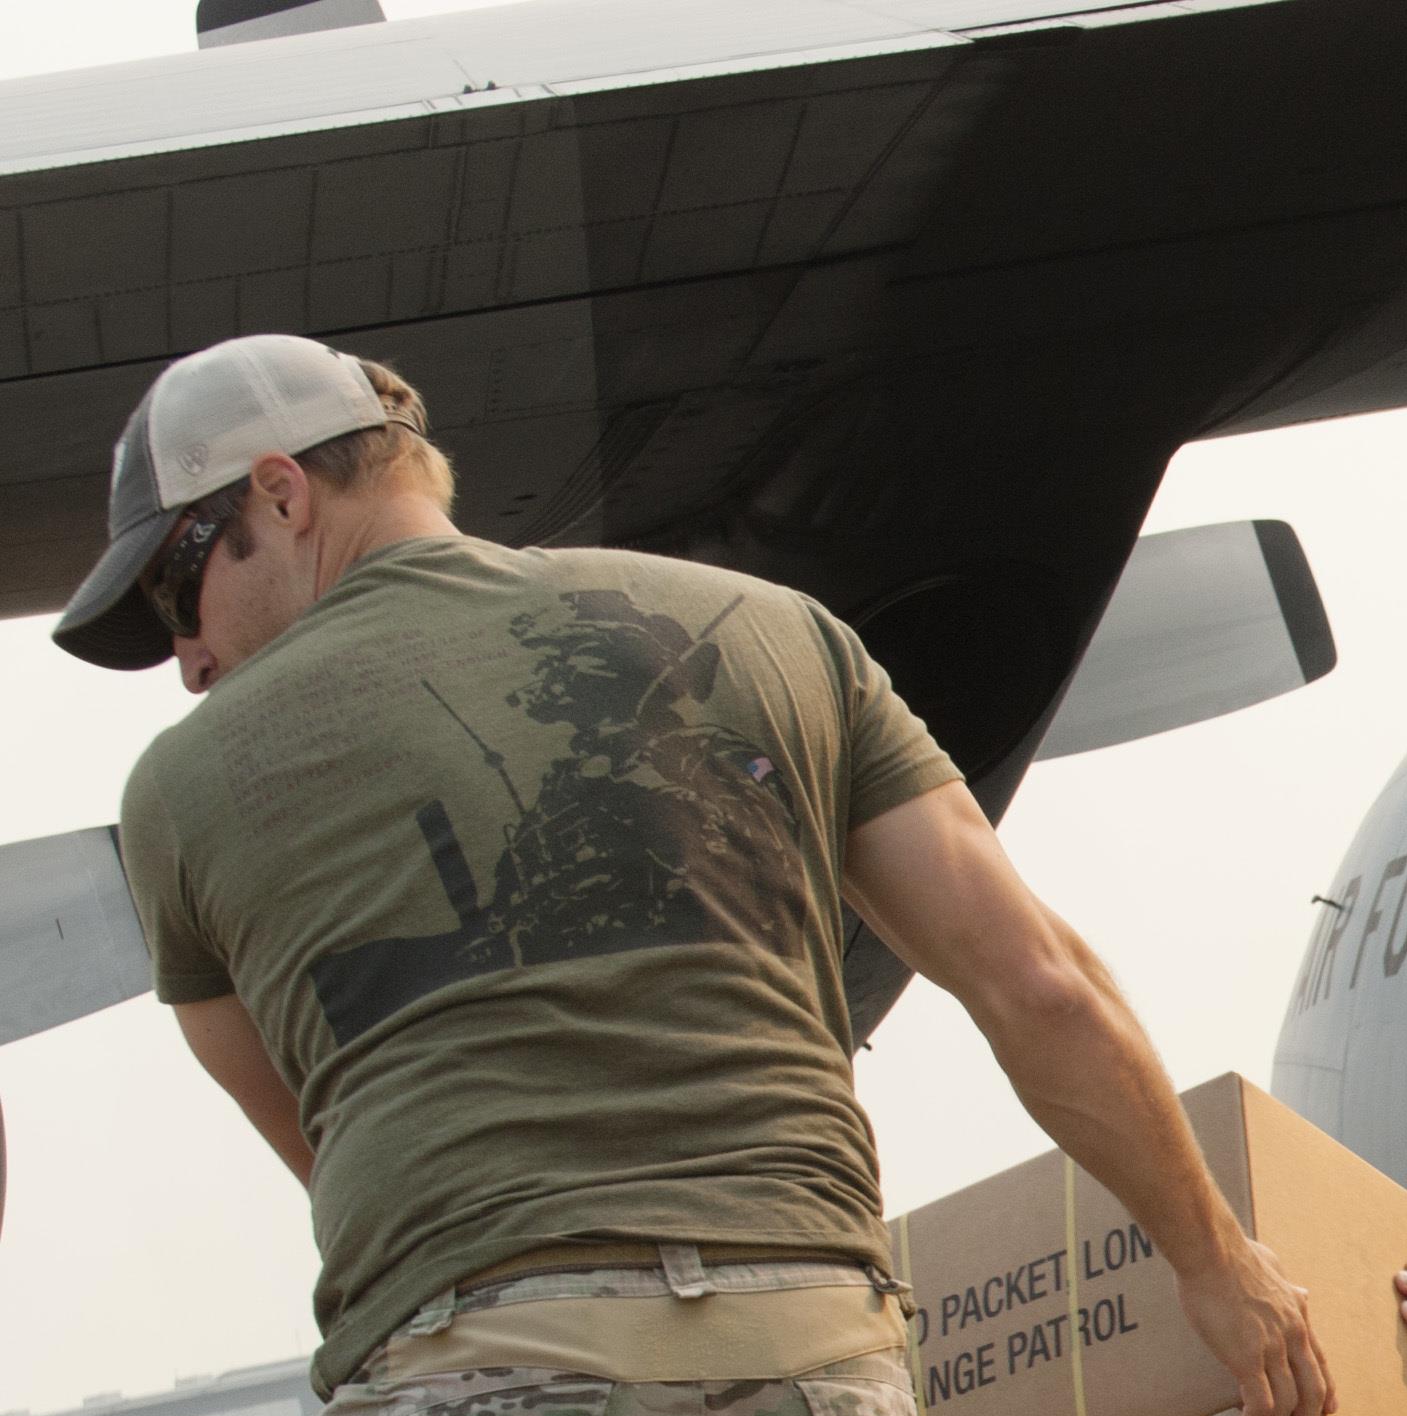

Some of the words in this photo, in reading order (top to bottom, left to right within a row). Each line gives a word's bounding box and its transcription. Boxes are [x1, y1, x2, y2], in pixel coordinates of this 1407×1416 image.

[1084, 1223, 1153, 1280] LON
[923, 1342, 997, 1409] NGE
[1007, 1293, 1139, 1376] PATROL
